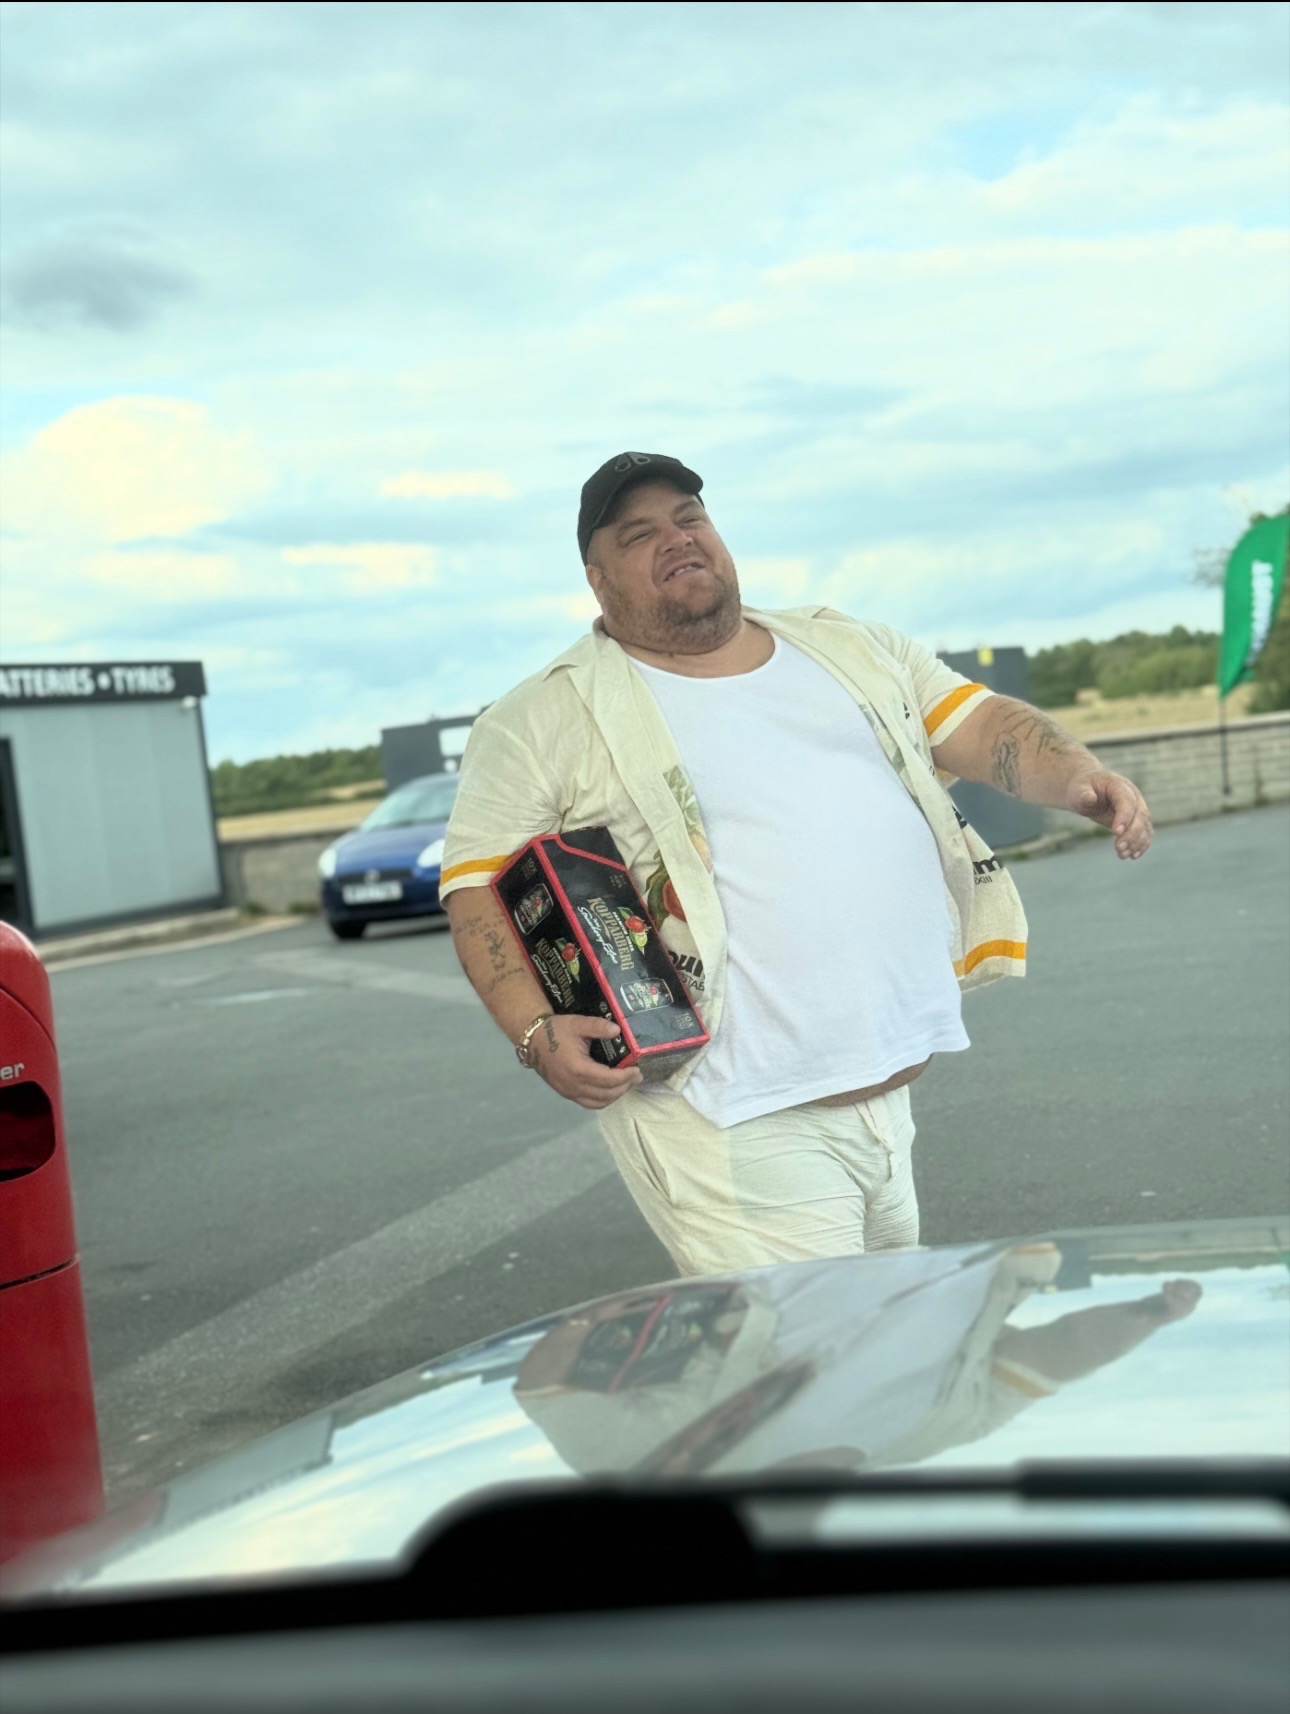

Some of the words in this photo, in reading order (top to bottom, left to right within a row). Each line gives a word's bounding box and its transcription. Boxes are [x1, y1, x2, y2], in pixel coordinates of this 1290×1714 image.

[110, 665, 176, 694] TYRES
[587, 897, 634, 970] KOPPARBERG
[535, 937, 575, 1008] KOPPARBERG
[0, 1062, 25, 1080] er
